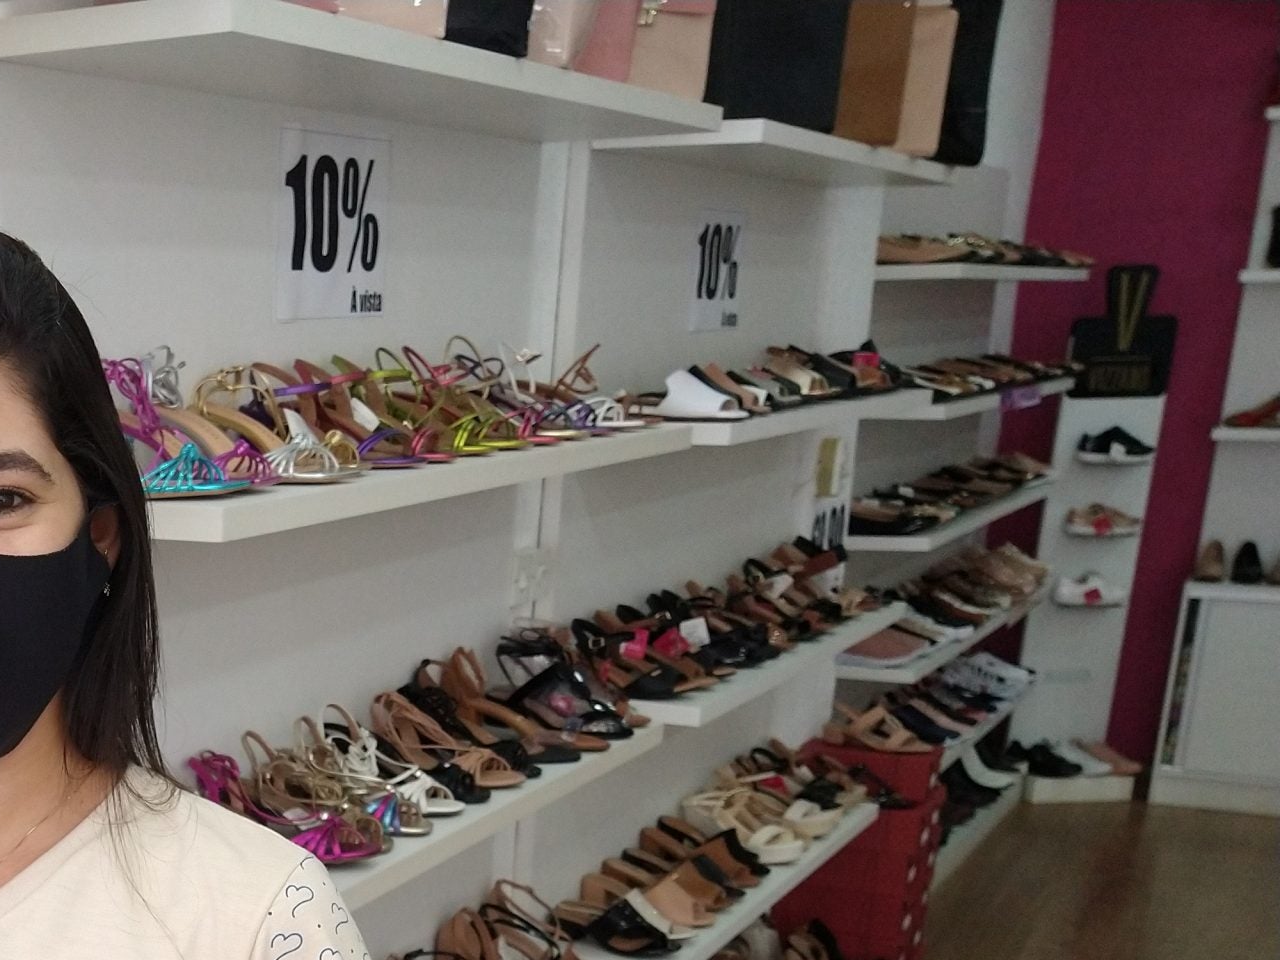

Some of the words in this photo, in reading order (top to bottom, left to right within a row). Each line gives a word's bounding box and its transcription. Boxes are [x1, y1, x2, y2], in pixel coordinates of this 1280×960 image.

[285, 154, 379, 273] 10%
[697, 222, 741, 300] 10%
[359, 290, 382, 313] vista
